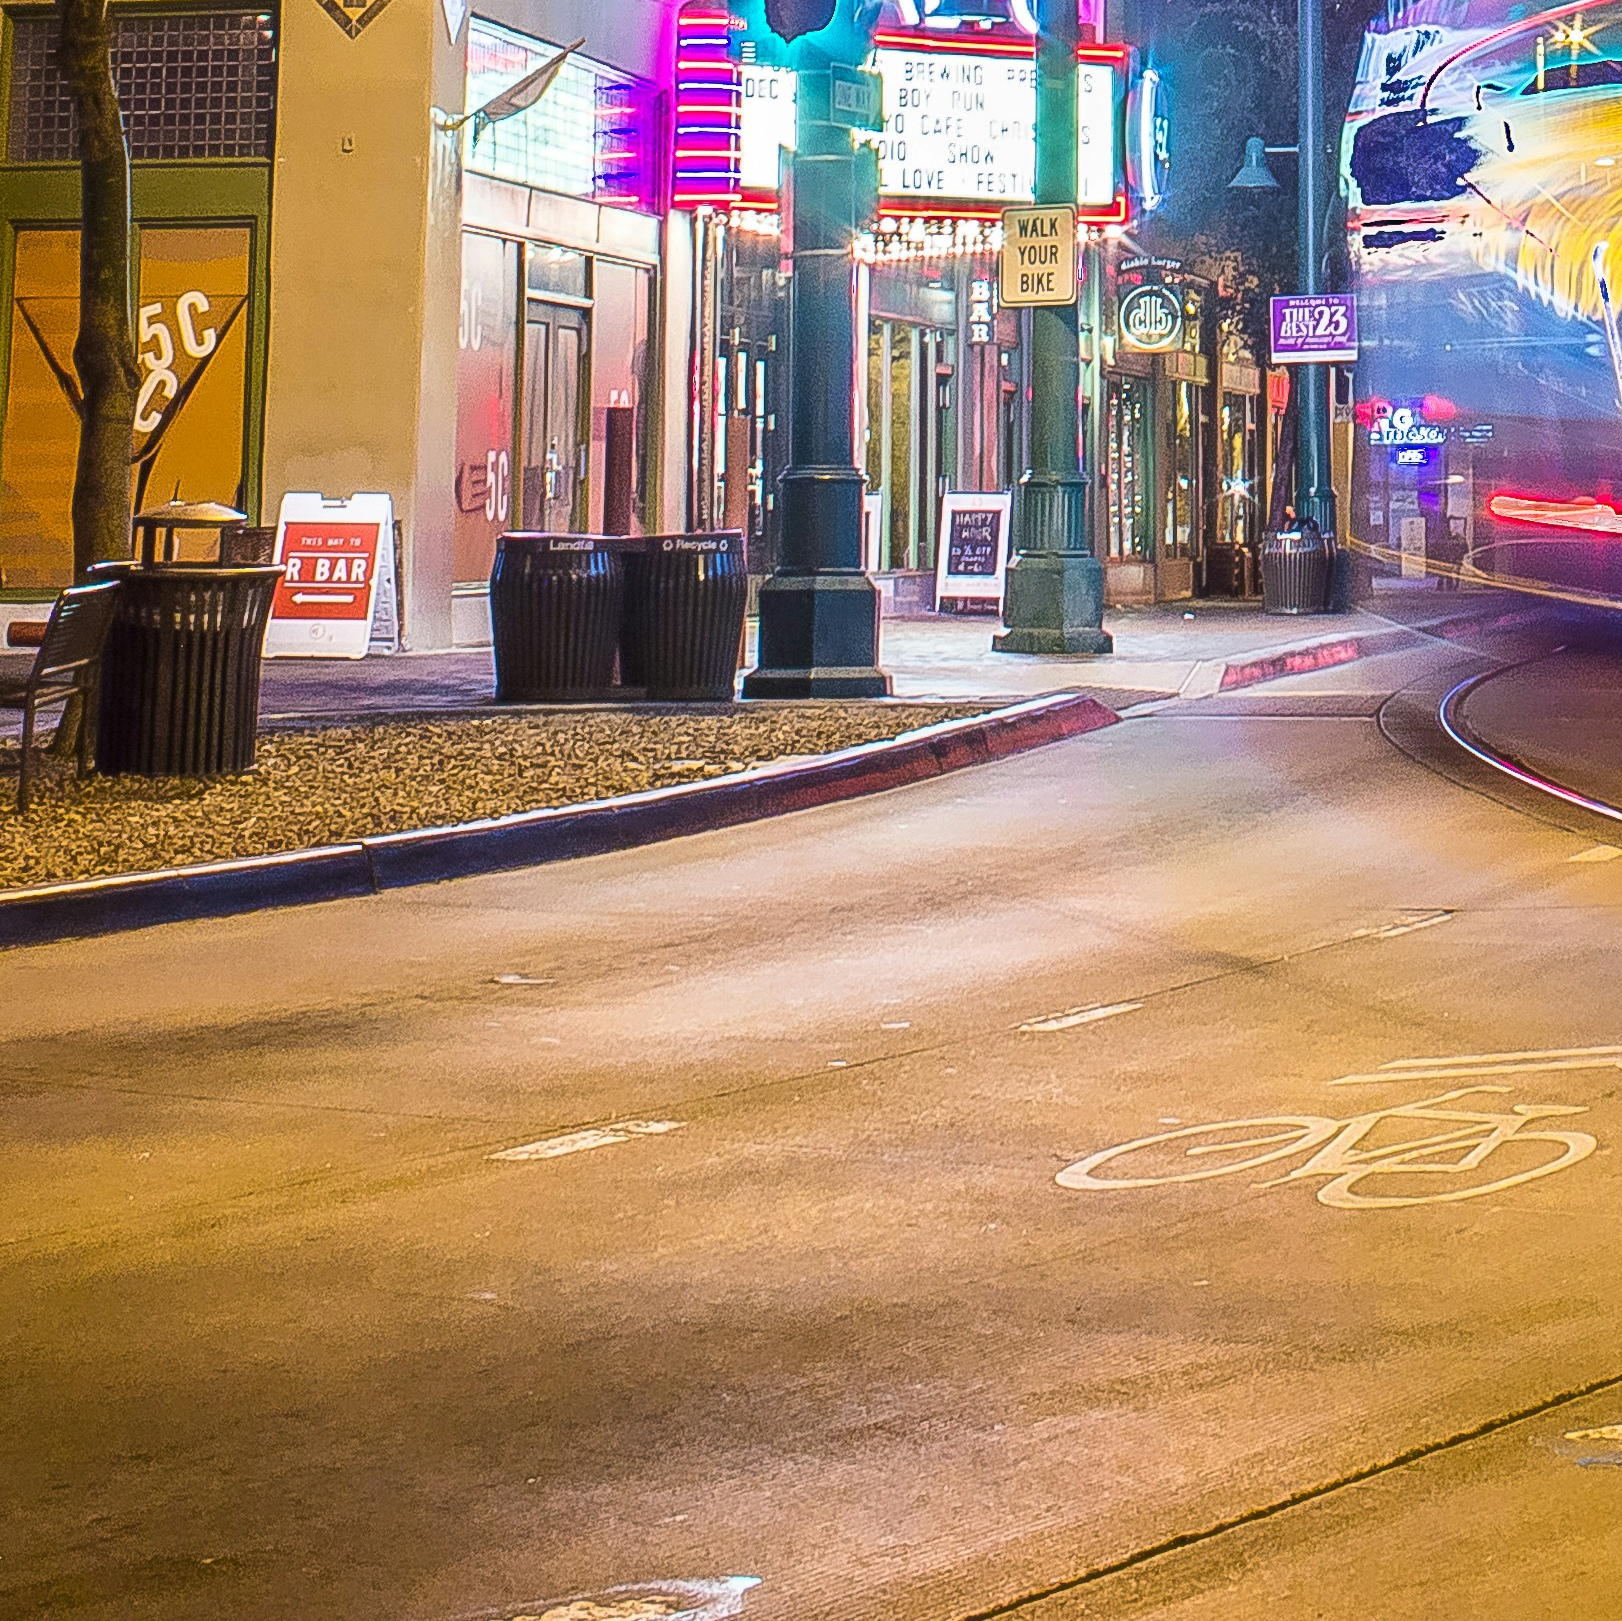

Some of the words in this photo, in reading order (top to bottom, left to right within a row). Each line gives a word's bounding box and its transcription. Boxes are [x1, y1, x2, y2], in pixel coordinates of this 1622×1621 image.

[904, 61, 984, 86] BREWING
[745, 77, 779, 100] DEC
[921, 114, 964, 138] CAFE
[947, 142, 995, 165] SHOW
[901, 168, 945, 191] LOVE
[1018, 217, 1059, 238] WALK
[1018, 244, 1059, 265] YOUR
[1020, 271, 1056, 295] BIKE
[970, 280, 992, 343] BAR
[1281, 307, 1315, 323] THE
[1313, 305, 1348, 336] 23
[137, 290, 217, 370] 5C
[1280, 321, 1317, 337] BEST
[486, 450, 508, 522] 5C
[954, 512, 994, 526] HAPPY
[301, 536, 323, 547] THIS
[327, 537, 346, 547] WAY
[349, 537, 363, 547] TO
[549, 539, 595, 551] Landfill
[675, 538, 718, 553] Recycle
[285, 557, 303, 582] R
[314, 557, 368, 583] BAR
